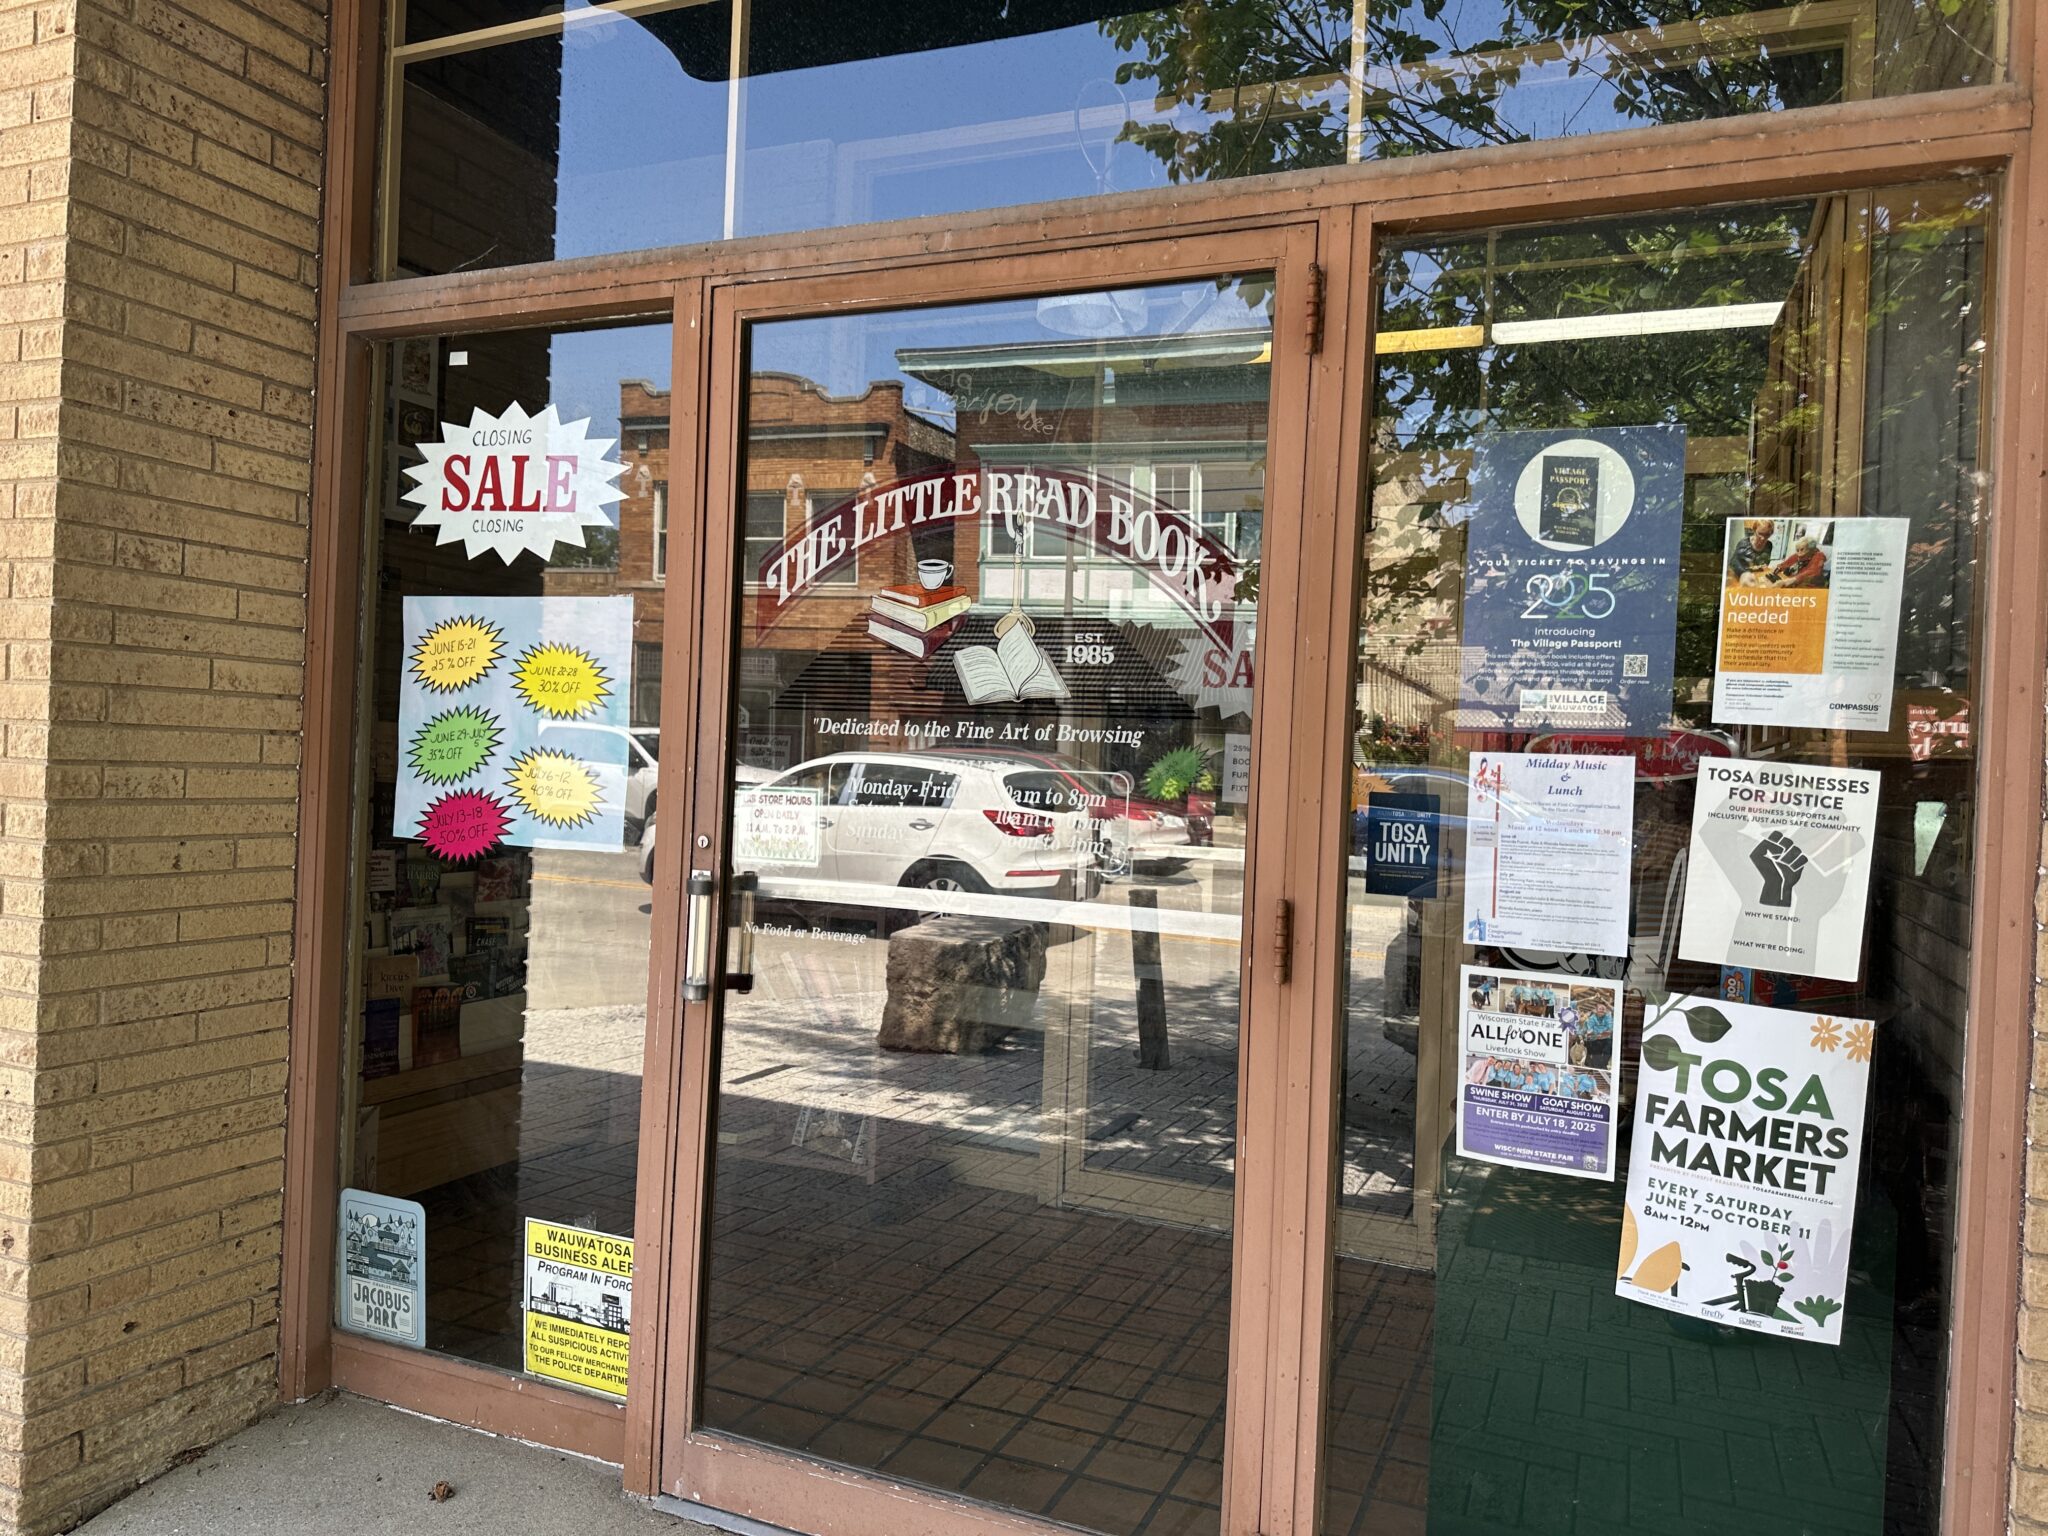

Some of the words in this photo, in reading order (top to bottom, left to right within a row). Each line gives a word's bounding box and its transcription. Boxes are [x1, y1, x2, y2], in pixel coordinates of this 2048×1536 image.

[979, 391, 1038, 425] you
[472, 429, 532, 447] CLOSING
[441, 454, 579, 513] SALE
[1549, 476, 1590, 485] PASSPORT
[473, 519, 524, 533] CLOSING
[766, 517, 848, 606] THE
[850, 473, 982, 550] LITTLE
[986, 473, 1096, 541] READ
[1107, 494, 1222, 622] BOOK
[1591, 558, 1646, 566] SAVINGS
[1520, 573, 1615, 619] 2025
[1729, 593, 1816, 608] Volunteers
[1728, 610, 1789, 624] needed
[1074, 633, 1105, 644] EST.
[1535, 627, 1595, 637] Introducing
[429, 640, 457, 656] JUNE
[457, 638, 477, 652] 15-21
[1511, 639, 1530, 648] The
[1533, 638, 1569, 649] Village
[1571, 639, 1622, 650] Passport!
[457, 656, 476, 668] OFF
[1065, 645, 1115, 665] 1985
[529, 667, 557, 676] JUNE
[556, 667, 579, 676] 22-28
[1203, 650, 1254, 688] SA
[538, 680, 560, 693] 30%
[561, 681, 581, 694] OFF
[1553, 694, 1605, 704] VILLAGE
[1829, 702, 1879, 711] COMPASSUS
[430, 730, 456, 744] JUNE
[903, 719, 920, 739] to
[924, 717, 950, 740] the
[955, 719, 994, 740] Fine
[1000, 721, 1029, 741] Art
[1033, 721, 1054, 742] of
[1056, 723, 1145, 748] Browsing
[474, 739, 480, 748] 5
[427, 749, 446, 761] 35%
[446, 748, 463, 760] OFF
[524, 767, 546, 780] JULY
[1525, 758, 1570, 771] Midday
[1573, 760, 1608, 771] Music
[1560, 773, 1571, 782] &
[1708, 768, 1754, 784] TOSA
[1759, 772, 1870, 794] BUSINESSES
[530, 784, 554, 797] 40%
[555, 786, 573, 799] OFF
[1045, 787, 1063, 805] to
[1068, 789, 1107, 810] 8pm
[1548, 785, 1583, 796] Lunch
[1729, 787, 1766, 803] FOR
[1770, 790, 1844, 810] JUSTICE
[759, 795, 783, 805] STORE
[785, 796, 812, 806] HOURS
[432, 812, 455, 830] JULY
[454, 806, 483, 823] 13-18
[994, 810, 1039, 827] 10am
[1708, 812, 1750, 823] INCLUSIVE,
[1751, 815, 1769, 824] JUST
[1770, 817, 1788, 826] AND
[1789, 819, 1809, 828] SAFE
[1810, 821, 1861, 832] COMMUNITY
[1729, 805, 1746, 813] OUR
[1748, 806, 1784, 816] BUSINESS
[1786, 809, 1827, 820] SUPPORTS
[438, 828, 466, 845] 50%
[467, 823, 489, 839] OFF
[1379, 822, 1428, 844] TOSA
[1375, 842, 1431, 864] UNITY
[1744, 910, 1761, 919] WHY
[1762, 912, 1774, 920] WE
[1775, 914, 1801, 923] STAND:
[744, 921, 759, 934] No
[762, 923, 791, 937] Food
[794, 928, 807, 938] or
[811, 927, 867, 945] Beverage
[1733, 939, 1754, 948] WHAT
[1755, 942, 1777, 951] WE'RE
[1778, 944, 1805, 955] DOING:
[1478, 1013, 1517, 1024] Wisconsin
[1519, 1017, 1539, 1027] State
[1541, 1020, 1556, 1029] Fair
[1471, 1024, 1507, 1041] ALL
[1504, 1025, 1524, 1045] for
[1522, 1028, 1563, 1048] ONE
[1486, 1044, 1521, 1055] Livestock
[1524, 1047, 1546, 1058] Show
[1667, 1050, 1835, 1120] TOSA
[1470, 1087, 1500, 1099] SWINE
[1502, 1090, 1532, 1103] SHOW
[1542, 1097, 1570, 1110] GOAT
[1571, 1101, 1602, 1113] SHOW
[1476, 1107, 1509, 1120] ENTER
[1511, 1112, 1525, 1122] BY
[1526, 1113, 1551, 1126] JULY
[1553, 1119, 1568, 1129] 18,
[1571, 1121, 1596, 1133] 2025
[1645, 1093, 1849, 1160] FARMERS
[1534, 1151, 1557, 1160] STATE
[1558, 1154, 1574, 1162] FAIR
[1650, 1132, 1836, 1195] MARKET
[1648, 1177, 1699, 1198] EVERY
[1706, 1192, 1793, 1221] SATURDAY
[1752, 1186, 1834, 1206] TOSAFARMERSMARKET.COM
[1643, 1205, 1668, 1221] 8AM
[1680, 1214, 1710, 1233] 12PM
[1645, 1192, 1686, 1211] JUNE
[1798, 1228, 1811, 1239] 11
[547, 1229, 632, 1258] WAUWATOSA
[535, 1242, 598, 1266] BUSINESS
[537, 1261, 588, 1281] PROGRAM
[354, 1282, 410, 1314] JACOBUS
[367, 1304, 398, 1329] PARK
[1701, 1307, 1724, 1319] firefly
[535, 1319, 547, 1330] WE
[550, 1323, 605, 1344] IMMEDIATELY
[531, 1331, 546, 1341] ALL
[548, 1334, 598, 1354] SUSPICIOUS
[529, 1343, 538, 1351] TO
[540, 1346, 554, 1355] OUR
[556, 1350, 584, 1363] FELLOW
[535, 1354, 550, 1365] THE
[552, 1359, 582, 1374] POLICE
